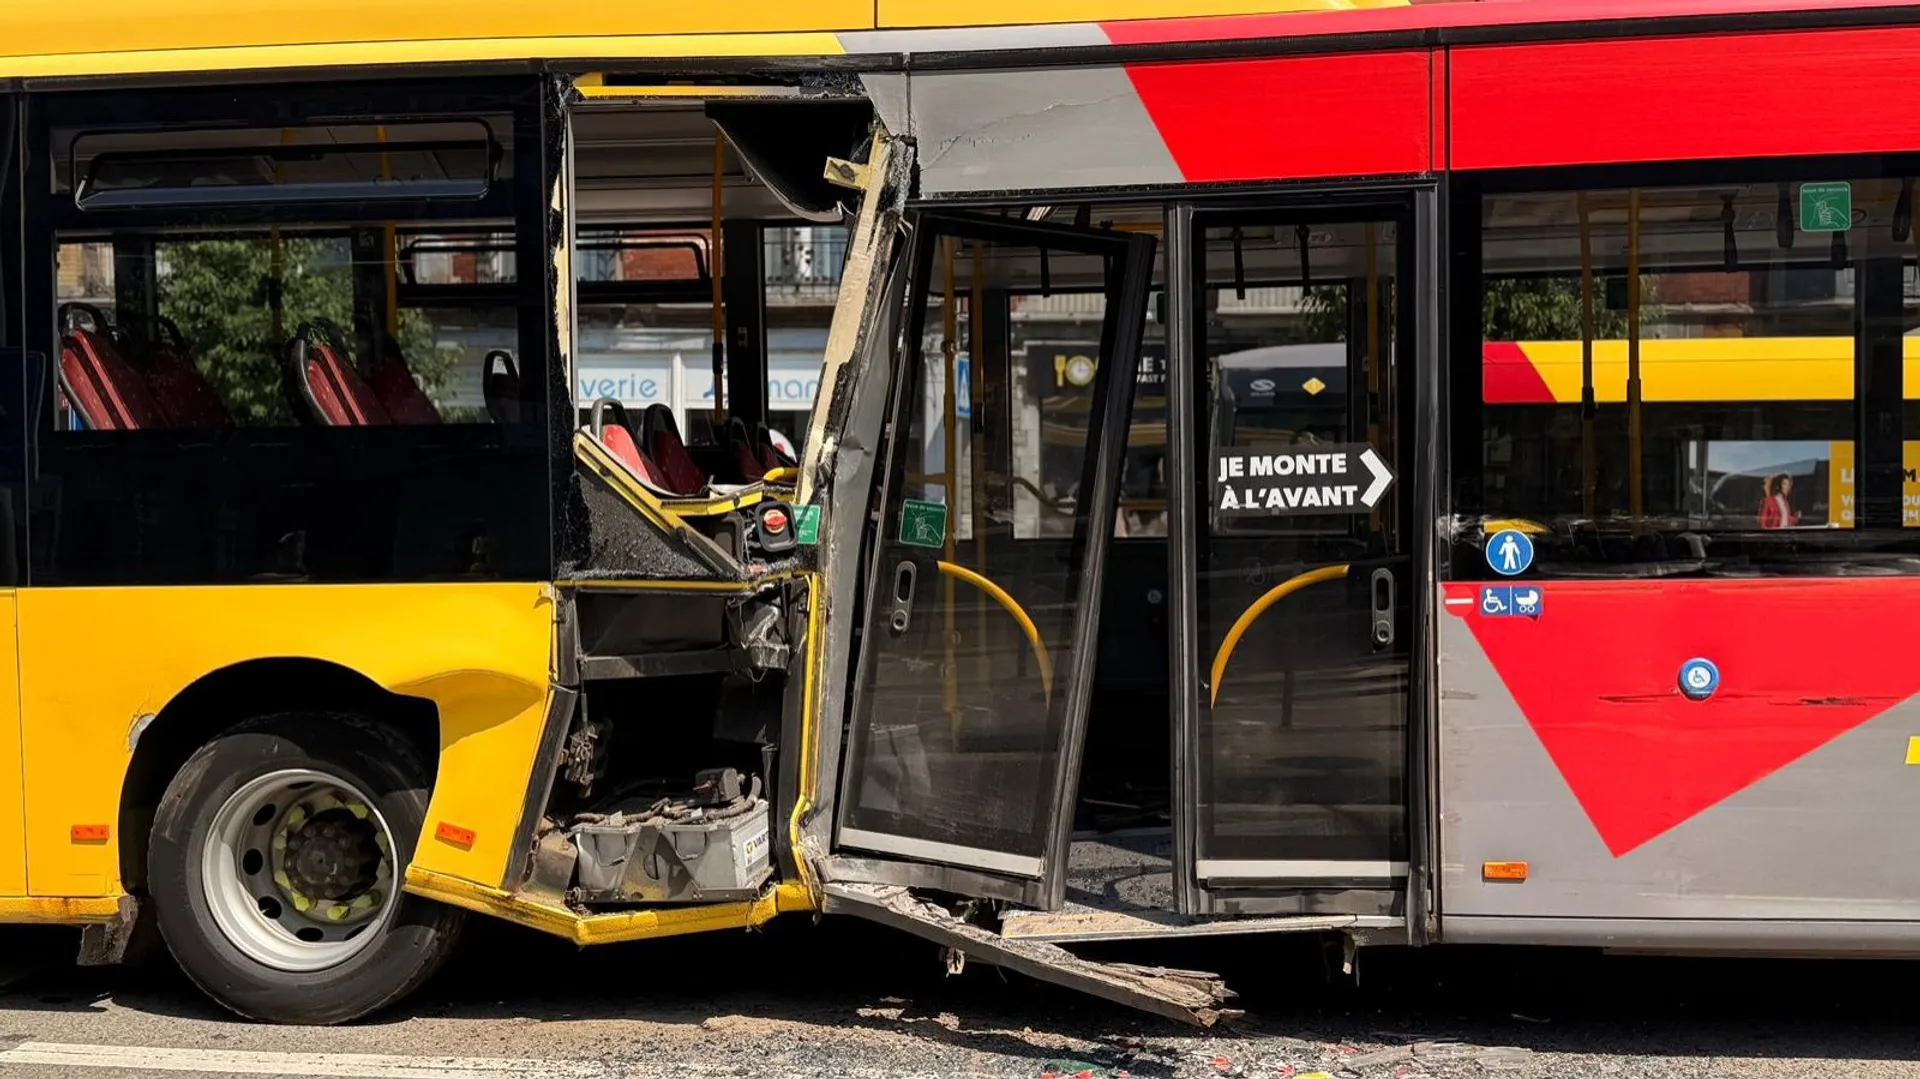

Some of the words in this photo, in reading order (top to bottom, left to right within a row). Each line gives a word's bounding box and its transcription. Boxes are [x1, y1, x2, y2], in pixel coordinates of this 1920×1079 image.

[580, 373, 657, 398] verie
[1218, 457, 1244, 482] JE
[1250, 453, 1347, 476] MONTE
[1220, 485, 1240, 509] À
[1245, 485, 1358, 509] L'AVANT
